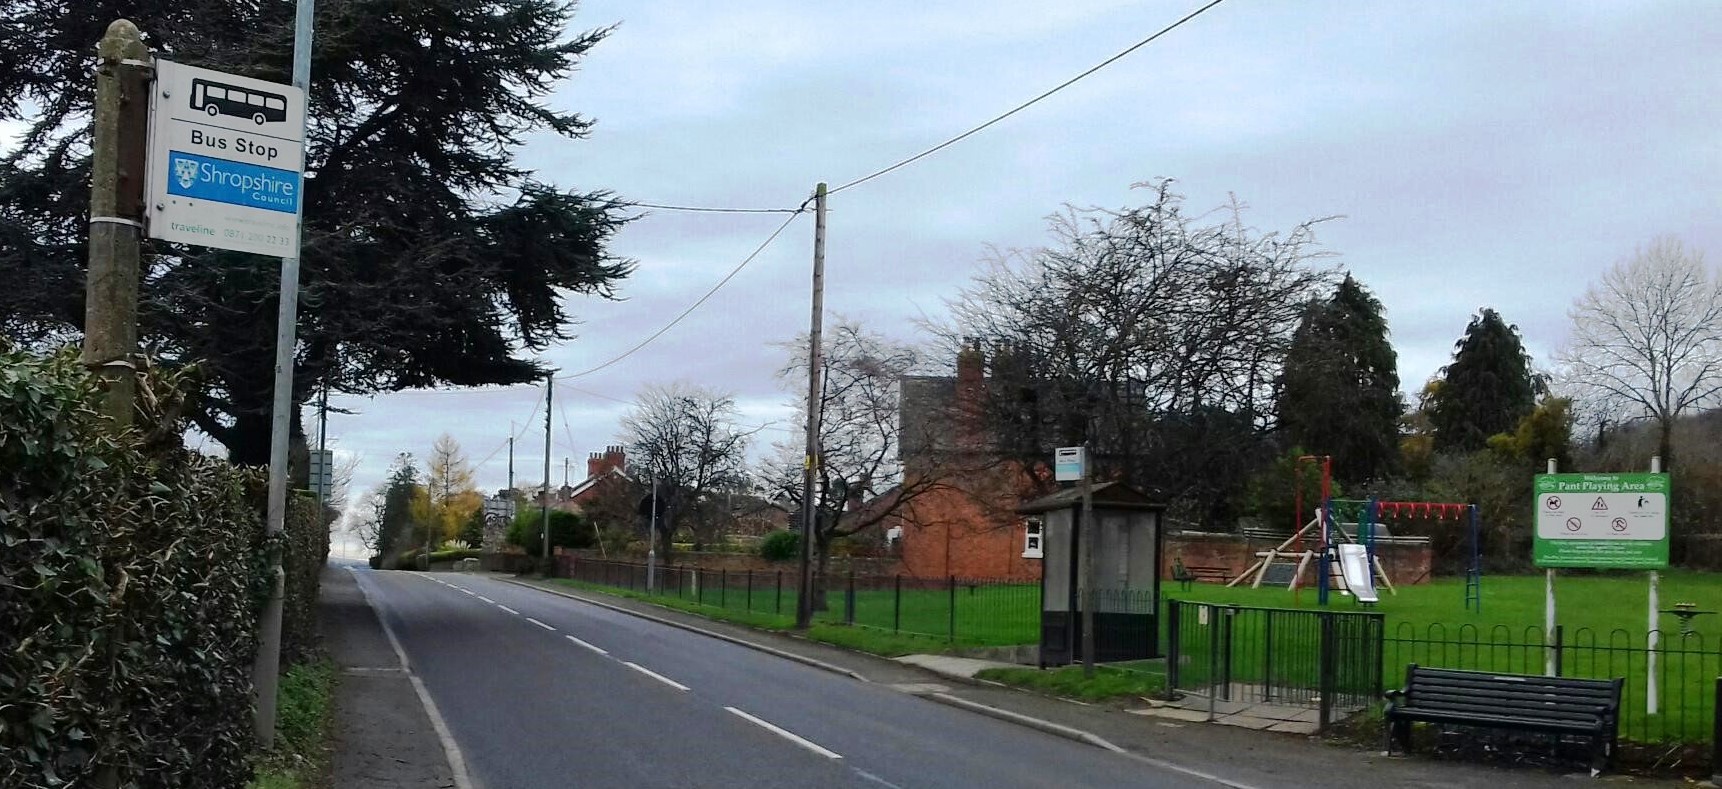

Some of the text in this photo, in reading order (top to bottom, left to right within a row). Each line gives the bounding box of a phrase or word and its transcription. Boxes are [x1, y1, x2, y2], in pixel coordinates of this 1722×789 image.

[191, 130, 278, 161] Bus Stop
[201, 162, 294, 196] Shropshire
[252, 192, 293, 206] Council
[171, 222, 216, 236] traveline
[1558, 481, 1645, 492] Pant Playing Area
